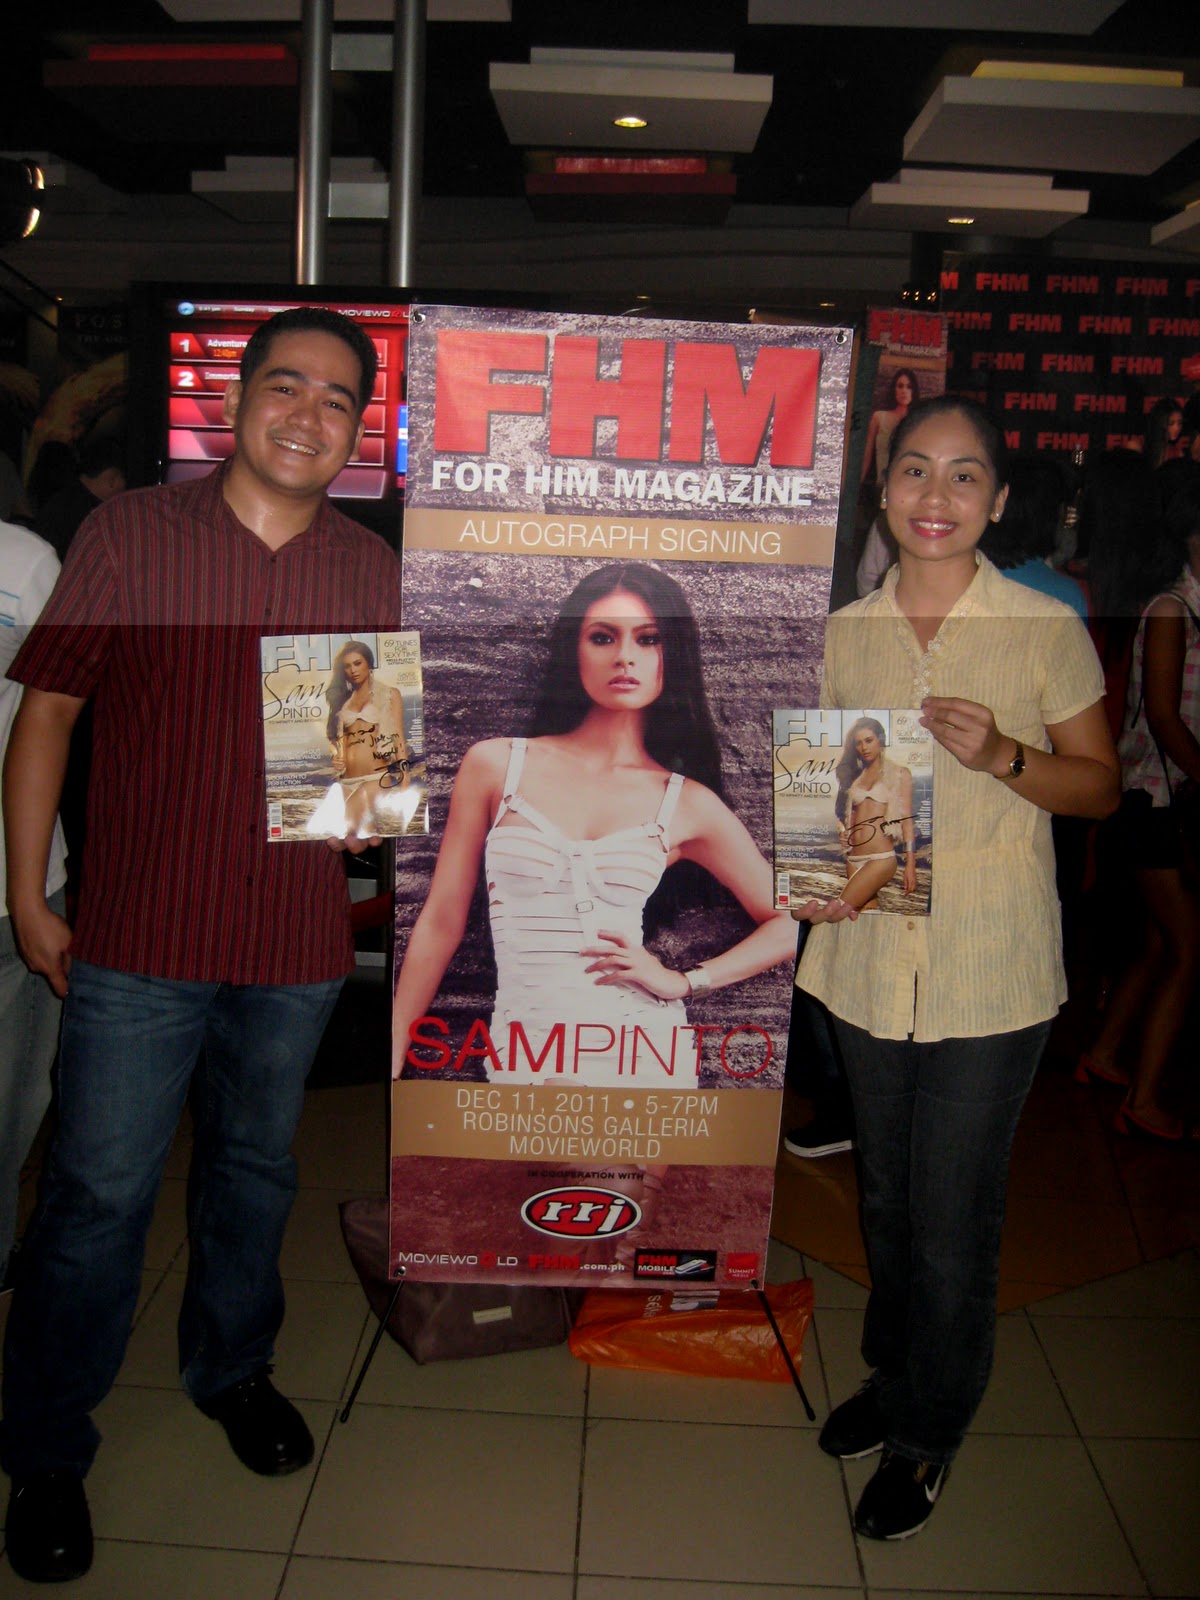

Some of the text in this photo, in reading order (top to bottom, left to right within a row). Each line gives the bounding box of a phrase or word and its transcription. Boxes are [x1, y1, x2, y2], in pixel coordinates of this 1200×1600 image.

[976, 273, 1029, 292] FHM
[1046, 275, 1099, 294] FHM
[1116, 277, 1168, 297] FHM
[867, 309, 943, 348] FHM
[1008, 313, 1062, 333] FHM
[1079, 315, 1132, 335] FHM
[1149, 317, 1200, 337] FHM
[180, 339, 190, 353] 1
[971, 352, 1025, 371] FHM
[1041, 354, 1094, 373] FHM
[1111, 356, 1164, 375] FHM
[178, 371, 195, 387] 2
[433, 329, 822, 469] FHM
[1004, 392, 1057, 411] FHM
[1074, 395, 1127, 414] FHM
[1037, 432, 1089, 451] FHM
[431, 460, 814, 507] FOR HIM MAGAZINE
[459, 519, 782, 556] AUTOGRAPH SIGNING
[262, 663, 329, 721] Sam
[282, 706, 322, 719] PINTO
[774, 738, 837, 793] Sam
[792, 781, 832, 794] PINTO
[456, 1089, 719, 1116] DEC 11, 2011 5-7PM
[462, 1111, 710, 1138] ROBINSONS GALLERIA
[509, 1136, 662, 1159] MOVIEWORLD
[541, 1170, 615, 1180] COOPERATION
[618, 1172, 645, 1180] WITH
[637, 1254, 678, 1266] FHM
[638, 1264, 676, 1273] MOBILE
[728, 1267, 756, 1275] SUMMIT
